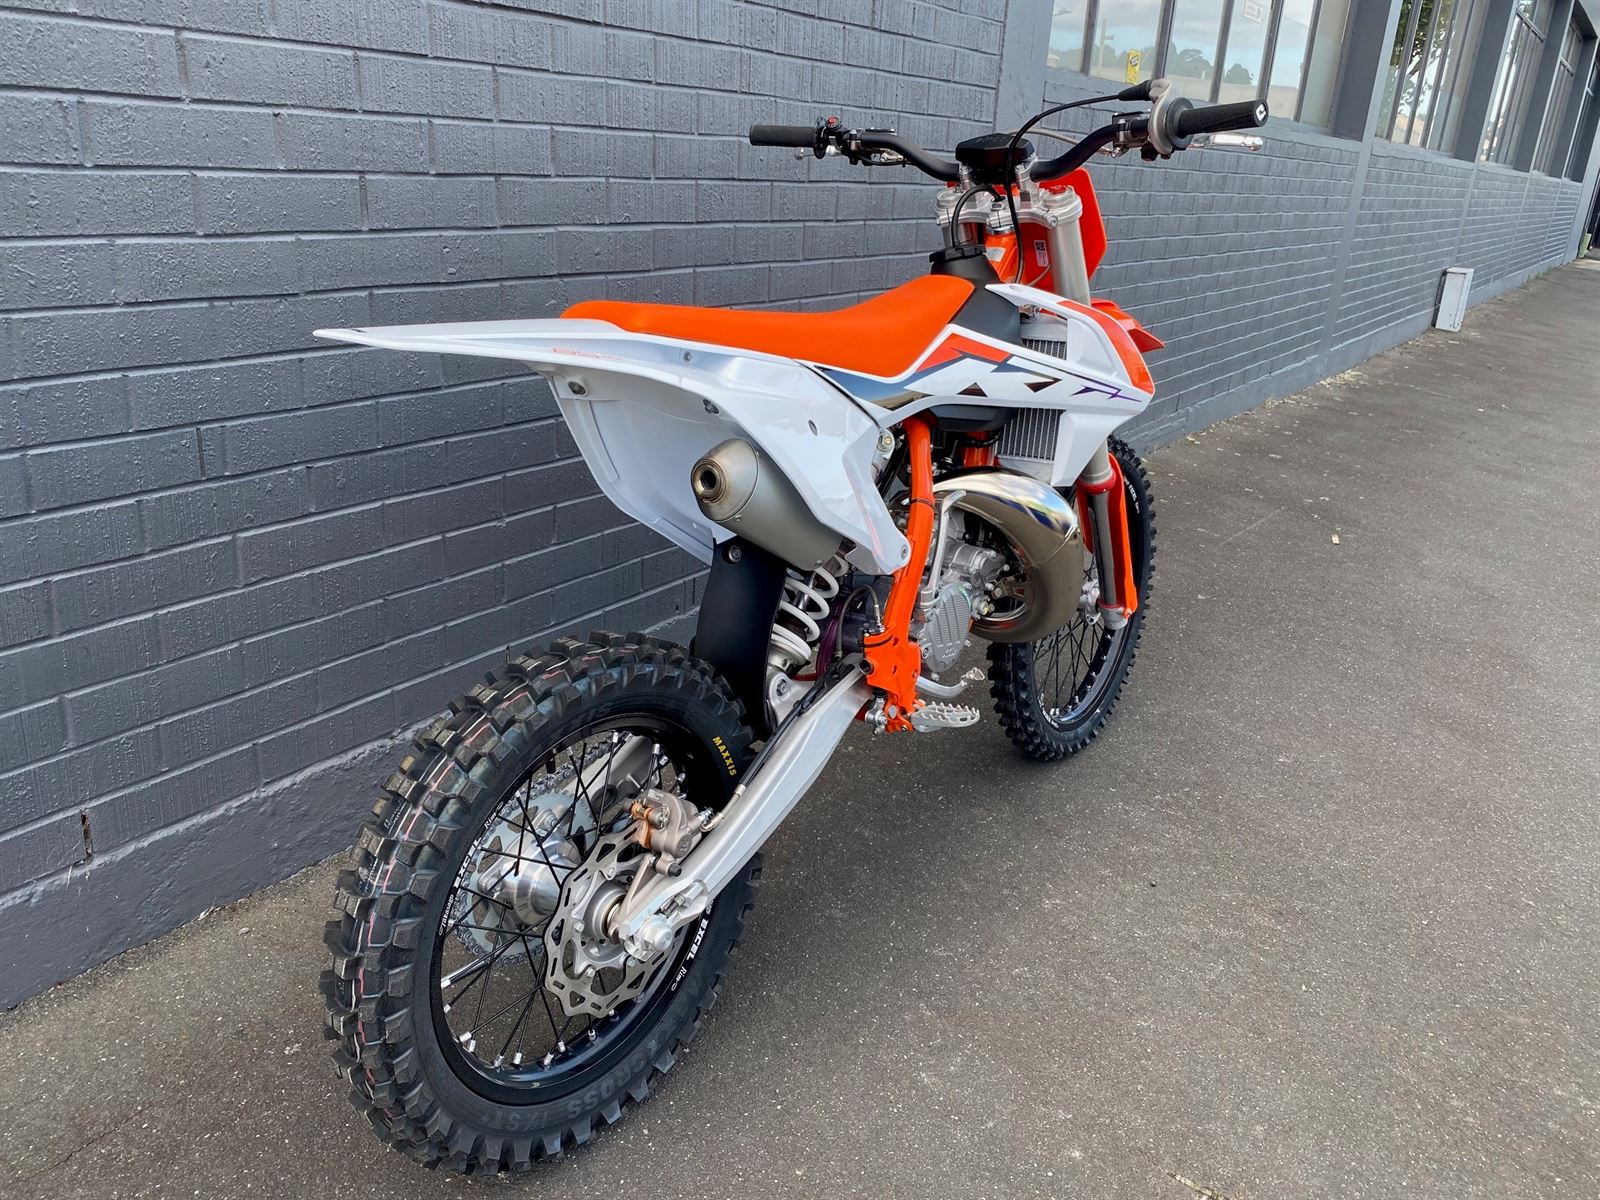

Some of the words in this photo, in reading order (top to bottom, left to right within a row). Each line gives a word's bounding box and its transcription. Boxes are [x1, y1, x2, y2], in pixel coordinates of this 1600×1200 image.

[712, 736, 737, 776] MAXXIS
[453, 837, 482, 889] EXCEL
[484, 811, 497, 830] Rim
[686, 918, 709, 961] EXCEL
[676, 966, 687, 982] Rim
